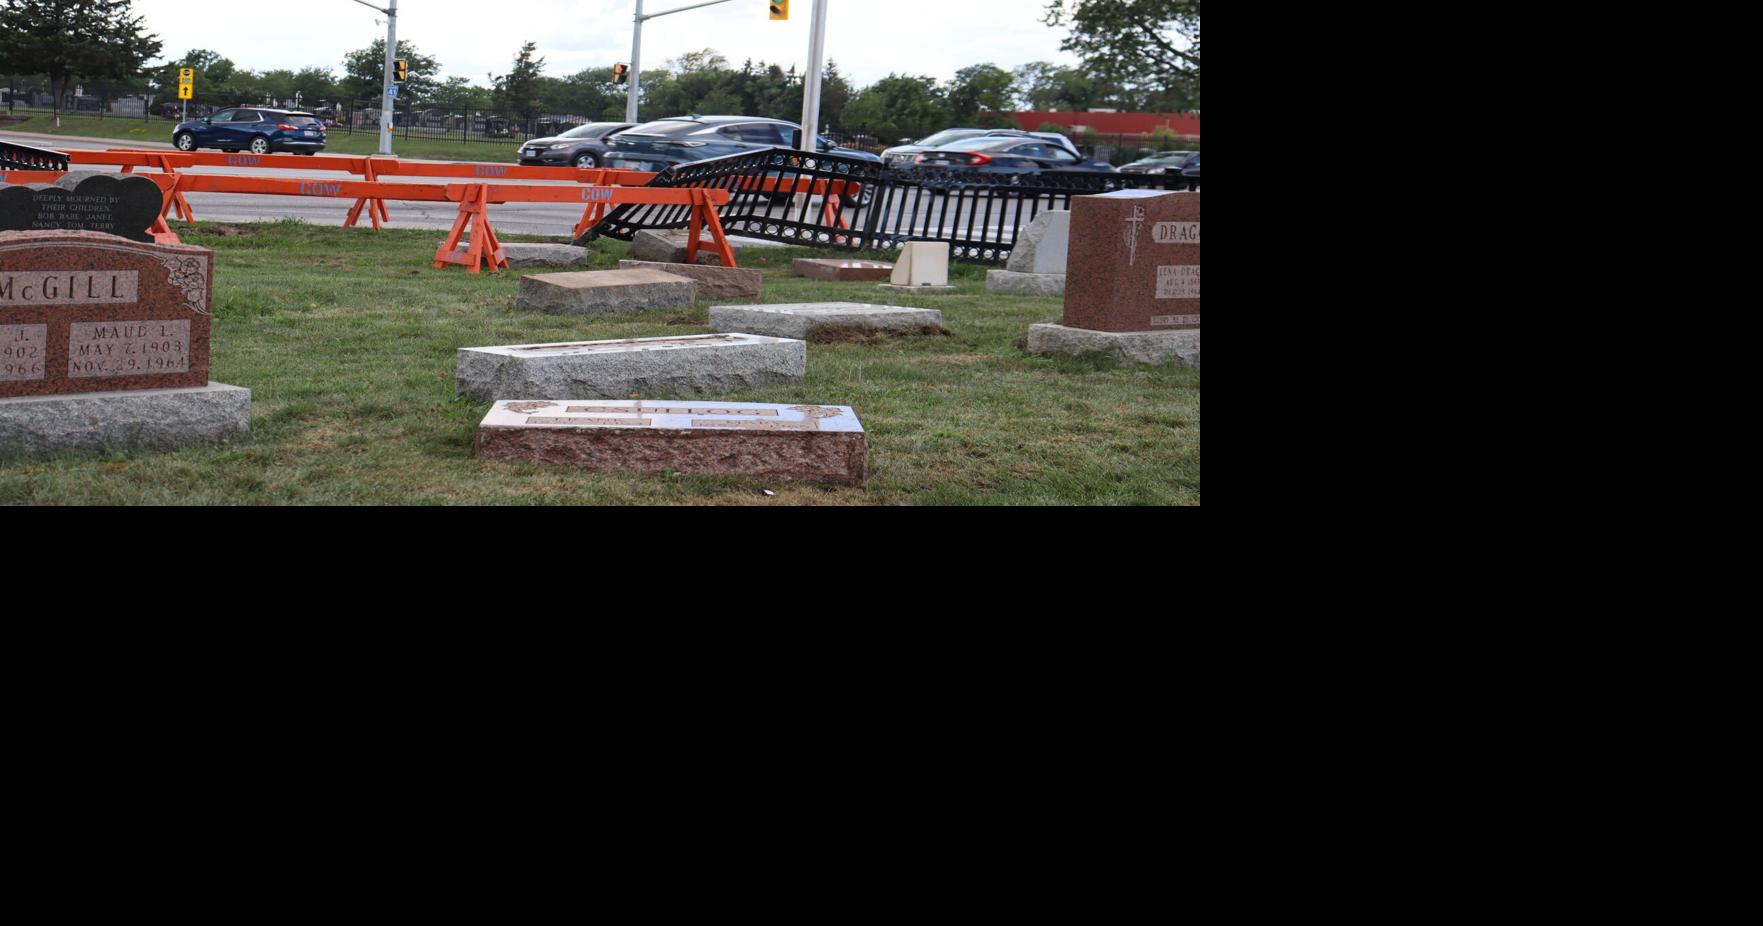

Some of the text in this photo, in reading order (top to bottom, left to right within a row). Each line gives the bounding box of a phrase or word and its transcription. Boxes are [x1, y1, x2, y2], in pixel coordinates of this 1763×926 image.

[299, 182, 342, 196] COW
[581, 187, 614, 201] COW
[66, 195, 107, 203] MOURNED
[41, 203, 66, 211] THEIR
[15, 329, 30, 342] J.
[92, 325, 147, 340] MAUD
[79, 343, 113, 357] MAY
